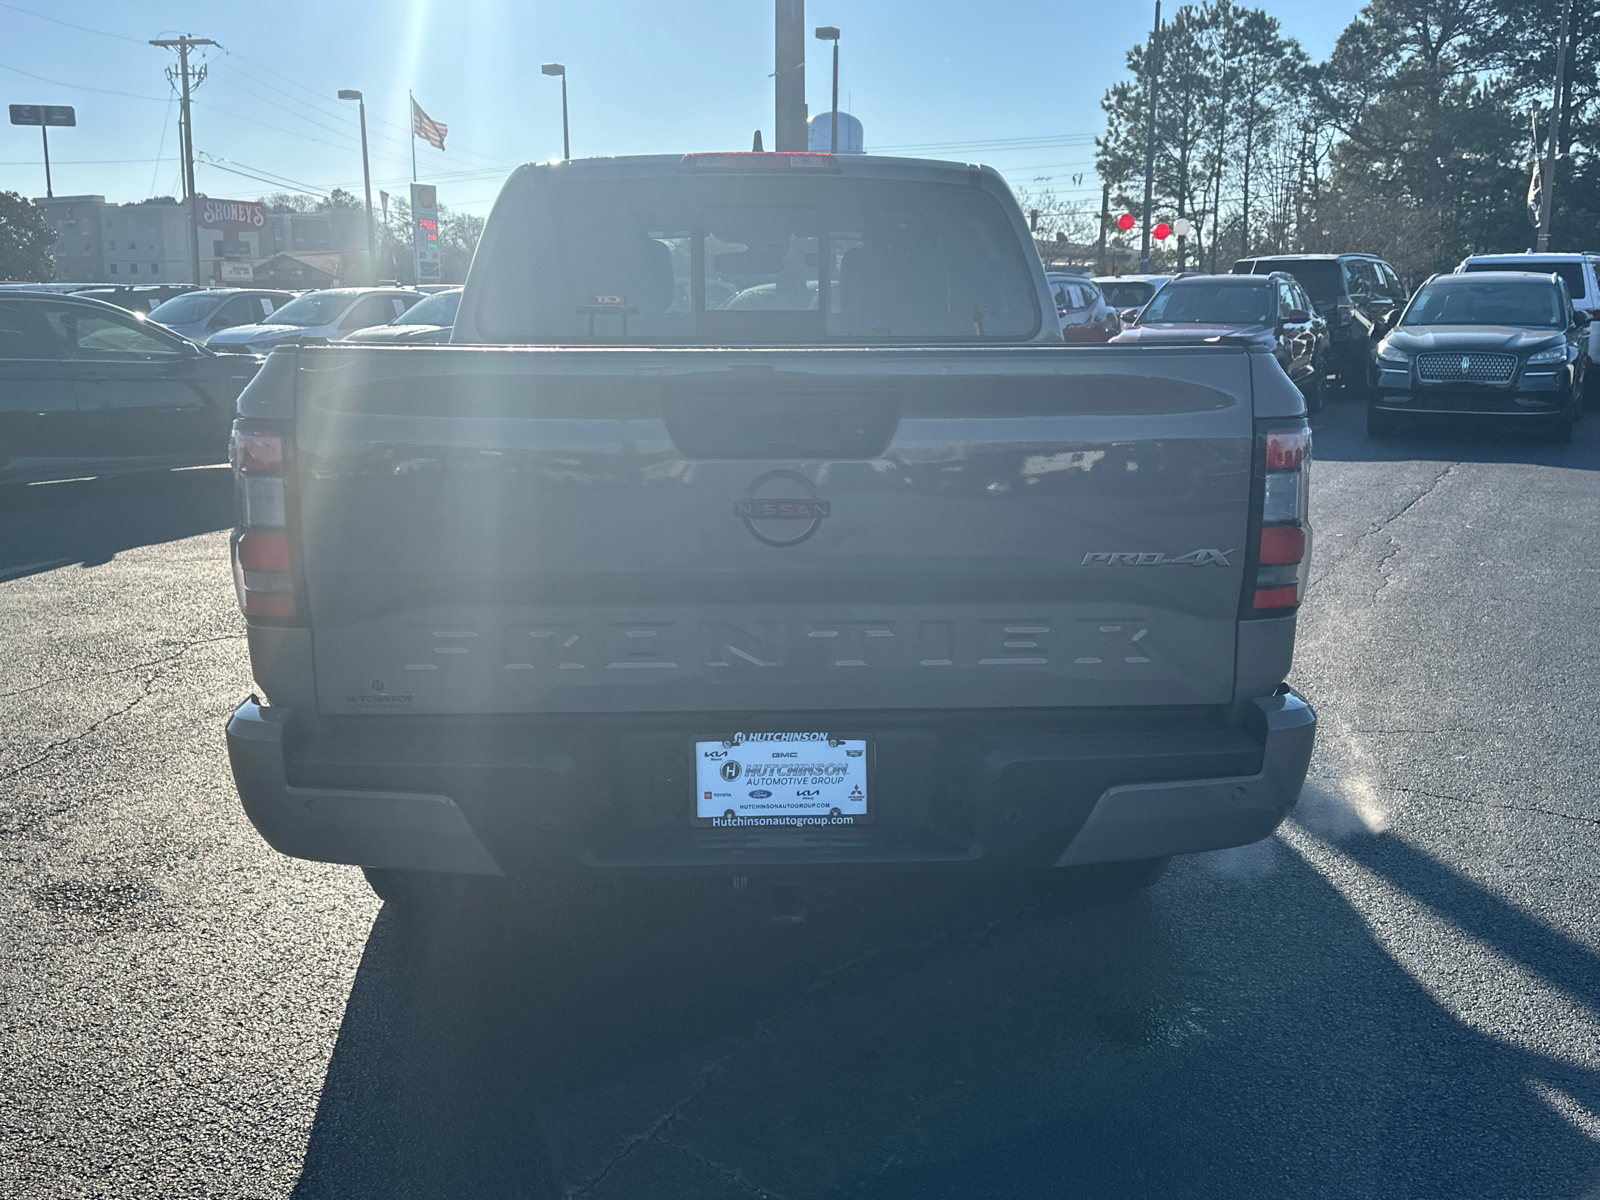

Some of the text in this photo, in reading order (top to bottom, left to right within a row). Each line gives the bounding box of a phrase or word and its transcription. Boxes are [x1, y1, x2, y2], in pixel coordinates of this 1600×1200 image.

[203, 201, 265, 227] SHONEY'S
[738, 503, 828, 516] NISSAN
[1081, 548, 1239, 568] PRO-4X
[405, 618, 1152, 670] FRONTIER
[345, 694, 414, 703] HUTCHINSON
[748, 732, 828, 742] HUTCHINSON
[744, 763, 849, 777] HUTCHINSON
[746, 776, 844, 786] AUTOMOTIVE GROUP
[739, 802, 830, 810] HUTCHINSONAUTOGROUP.COM
[712, 816, 854, 827] Hutchinsonautogroup.com
